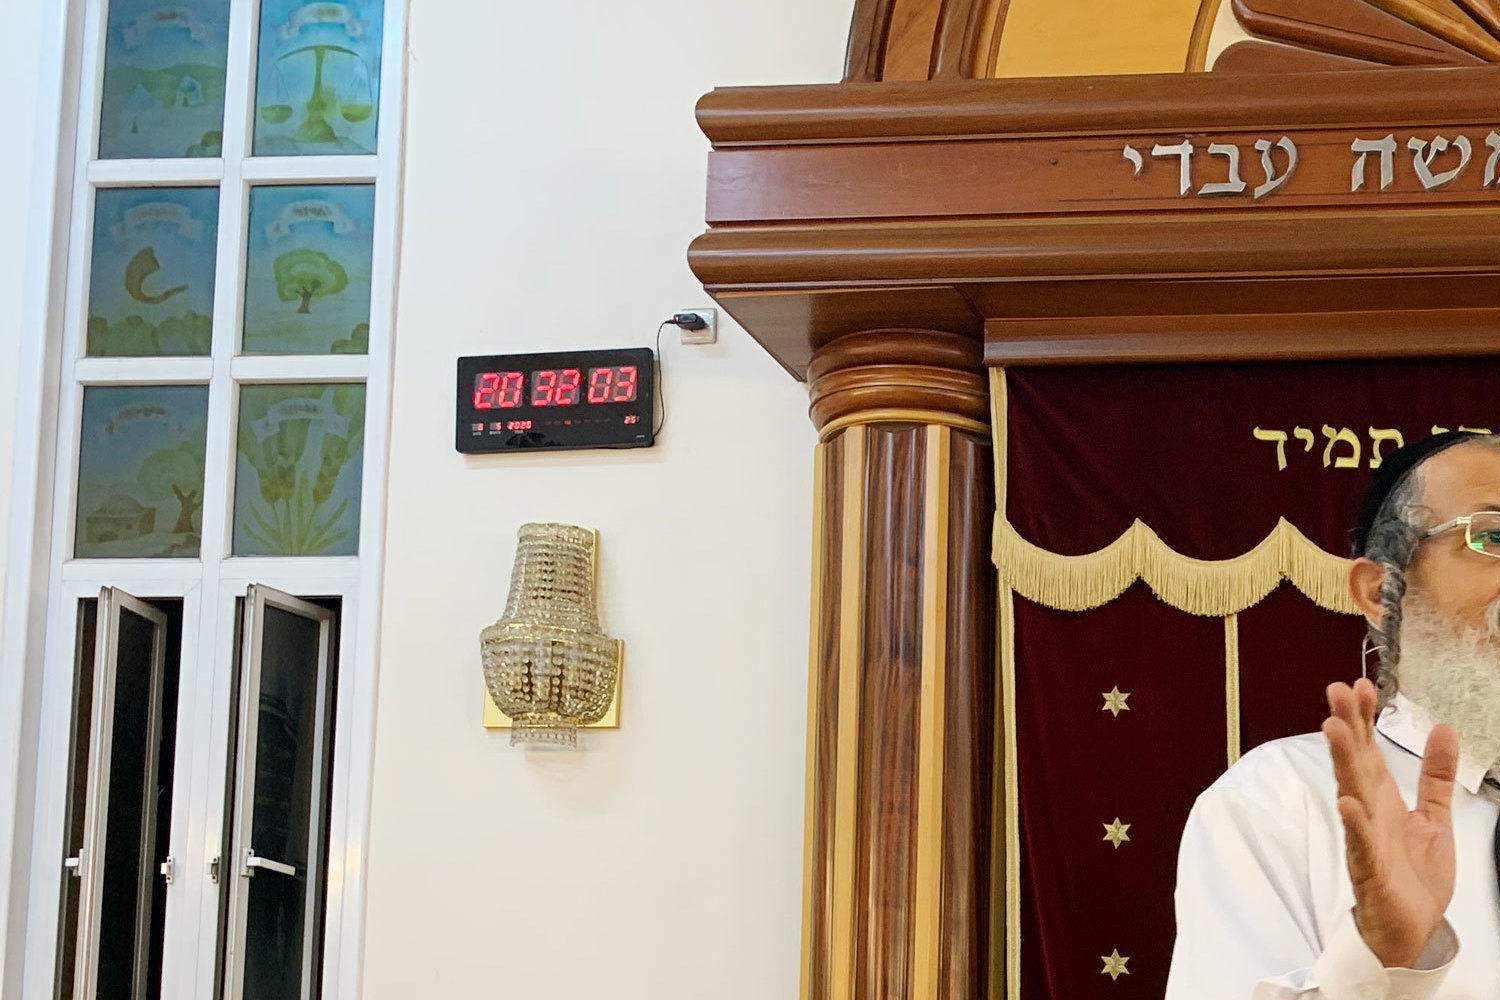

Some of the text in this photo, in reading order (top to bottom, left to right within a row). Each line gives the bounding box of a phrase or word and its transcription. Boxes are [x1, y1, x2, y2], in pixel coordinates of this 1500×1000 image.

[1123, 136, 1299, 199] עבדי
[474, 366, 637, 410] 20 32 03
[1253, 424, 1405, 471] תמיד
